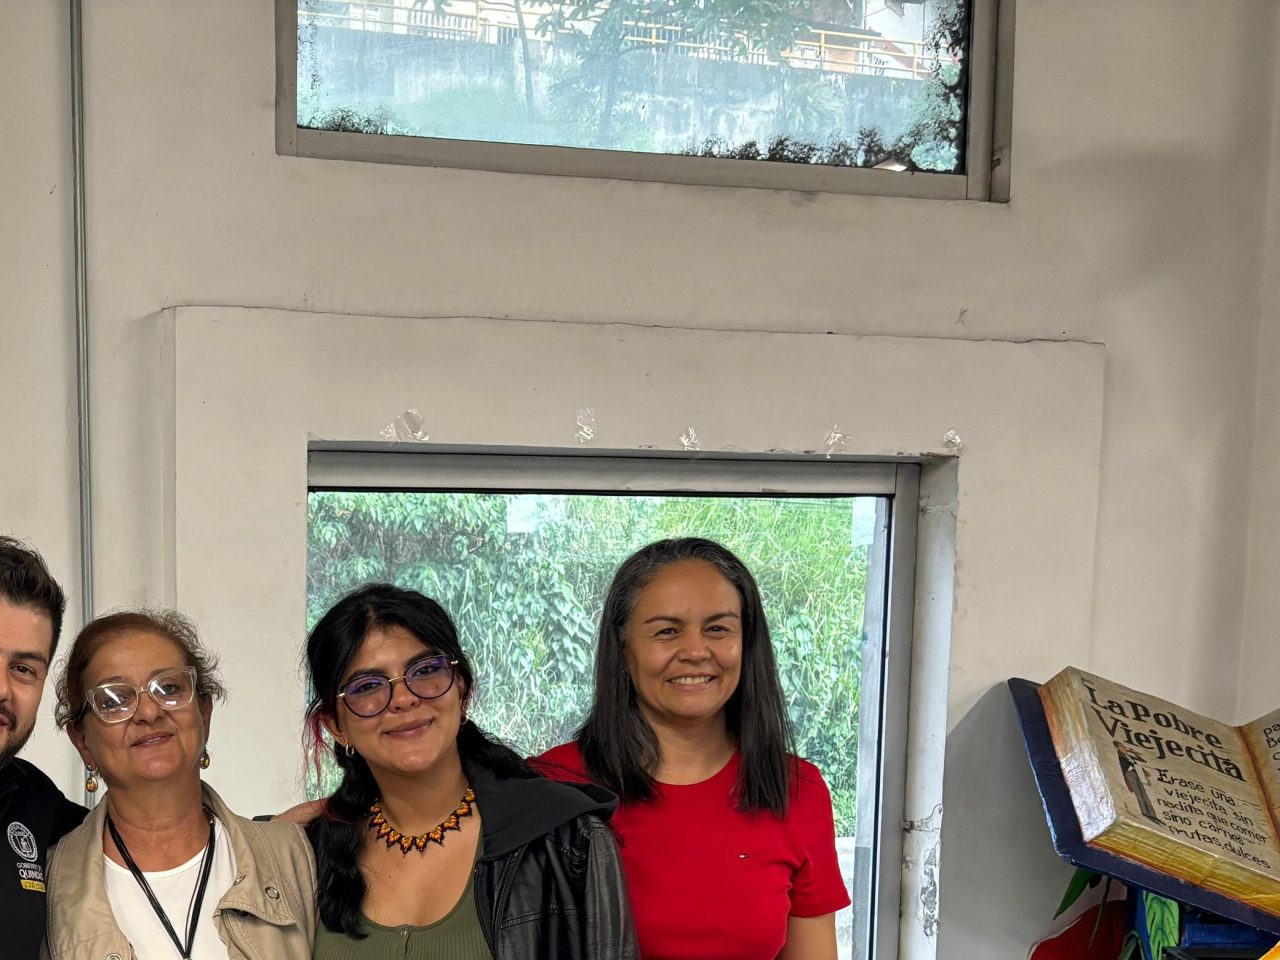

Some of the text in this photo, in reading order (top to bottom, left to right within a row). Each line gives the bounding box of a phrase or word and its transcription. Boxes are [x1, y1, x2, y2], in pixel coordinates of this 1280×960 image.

[1083, 684, 1224, 750] La Pobre
[1090, 706, 1248, 783] Viejecita
[1162, 809, 1193, 827] sino
[1164, 788, 1254, 827] viejecita sin
[1210, 788, 1235, 807] una
[1156, 798, 1268, 845] nadita que comer
